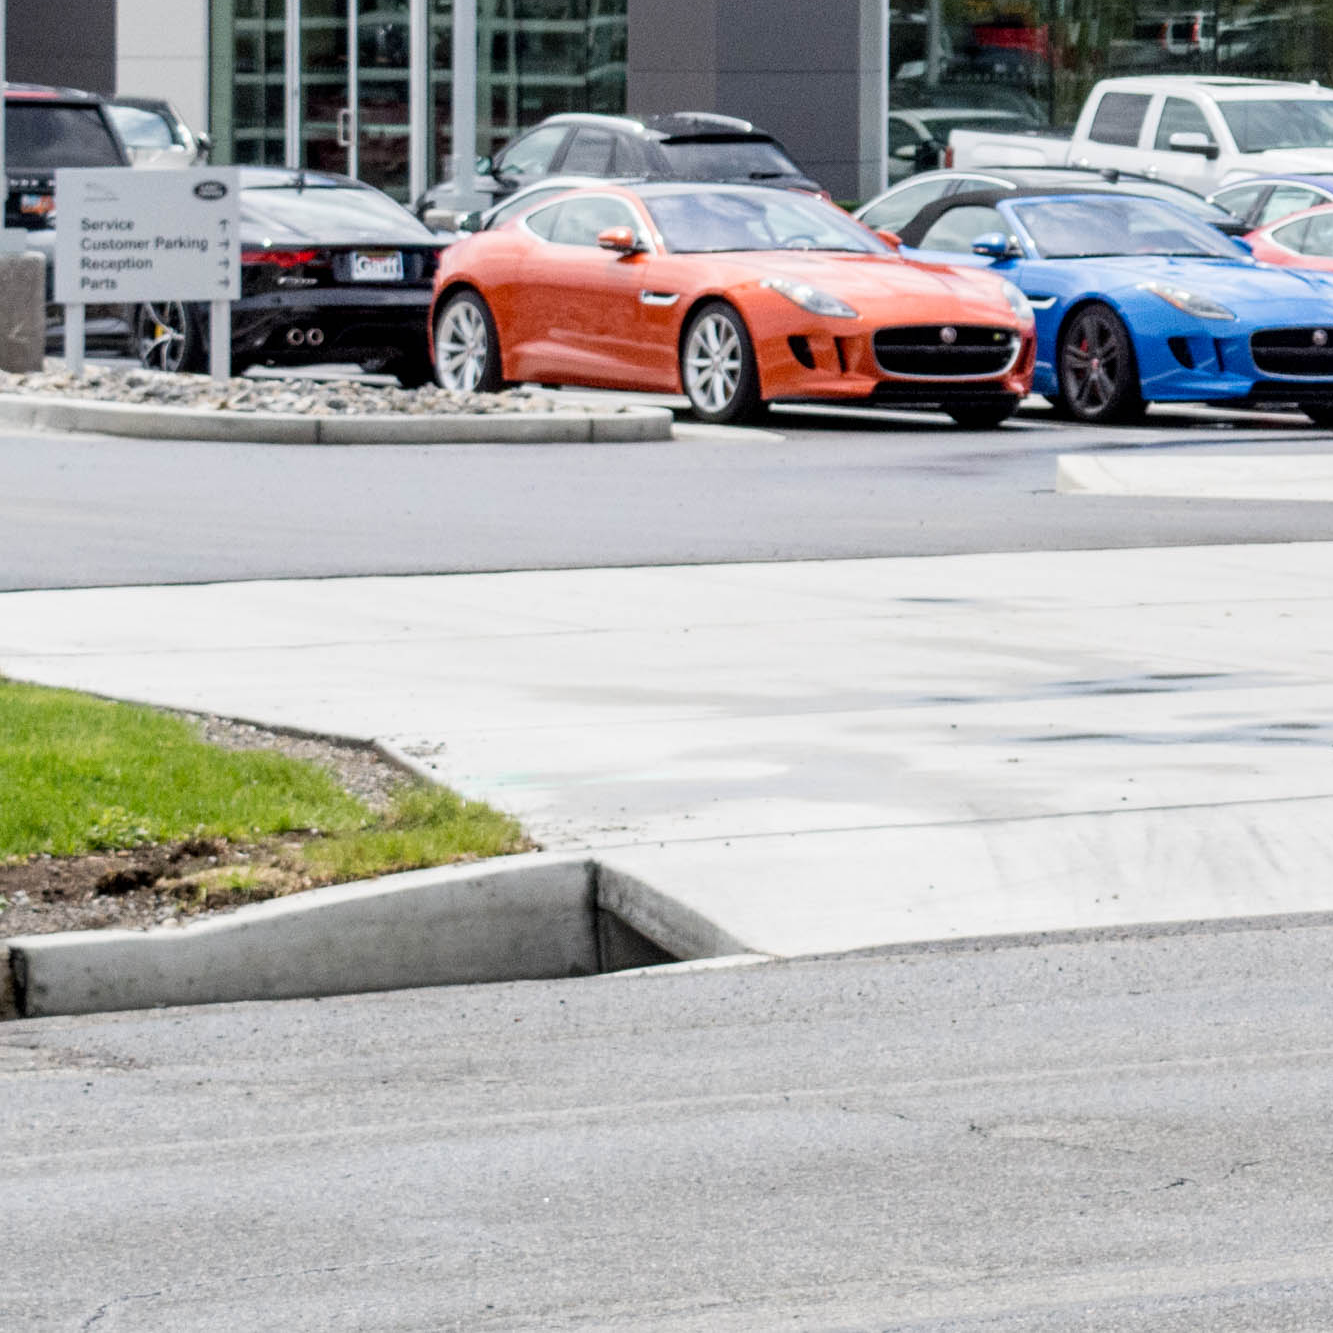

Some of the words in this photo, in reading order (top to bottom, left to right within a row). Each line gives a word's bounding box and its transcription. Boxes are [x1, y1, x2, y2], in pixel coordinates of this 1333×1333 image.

[80, 217, 135, 231] Service
[80, 238, 150, 251] Customer
[155, 236, 209, 251] Parking
[80, 256, 153, 272] Reception
[80, 277, 118, 290] Parts
